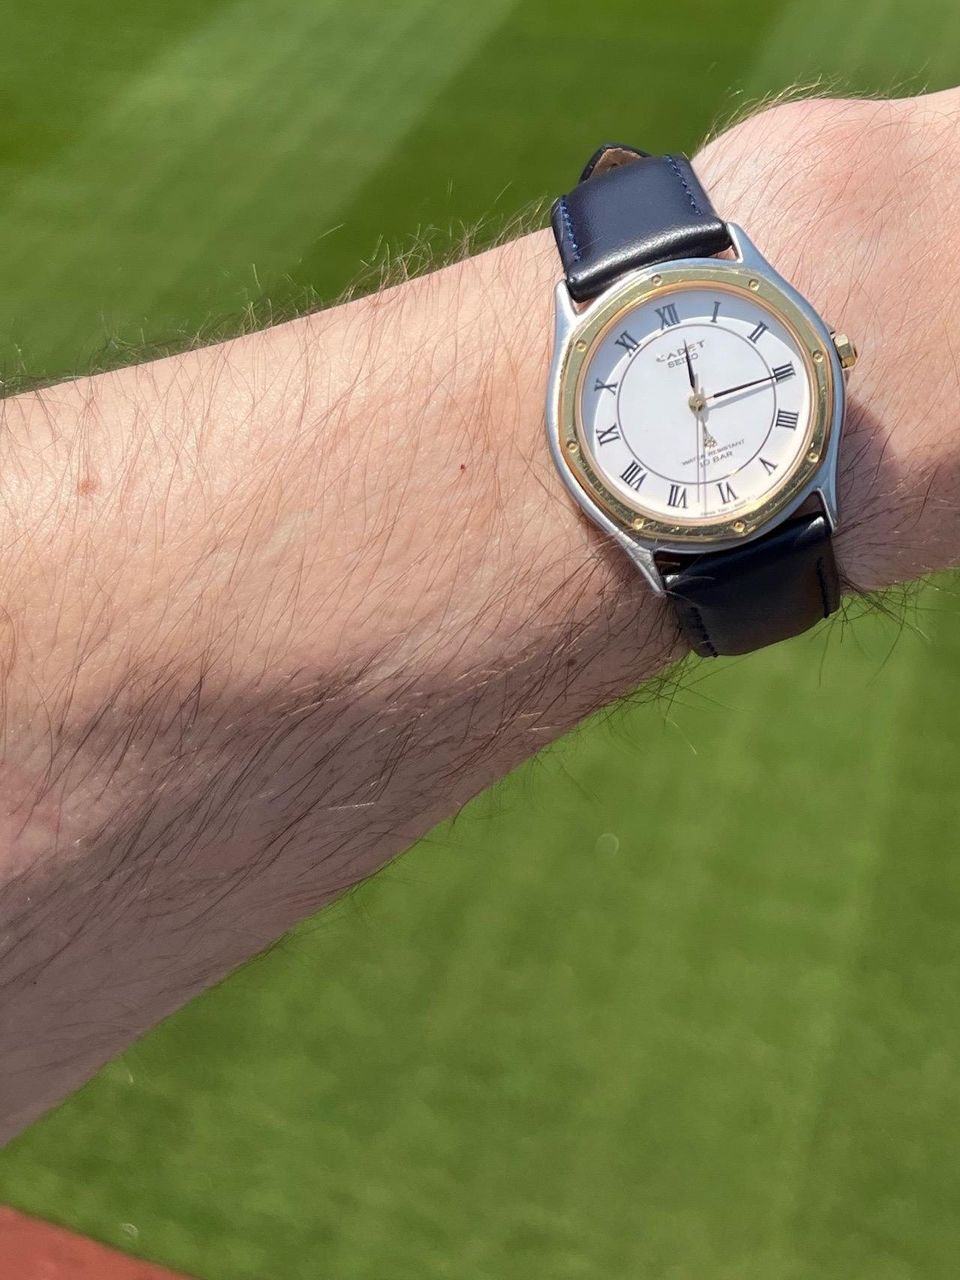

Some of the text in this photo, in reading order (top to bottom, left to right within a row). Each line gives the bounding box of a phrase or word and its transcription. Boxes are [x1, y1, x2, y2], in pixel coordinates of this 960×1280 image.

[654, 303, 680, 330] XII
[711, 301, 722, 322] I
[748, 321, 769, 343] II
[615, 331, 641, 357] XI
[668, 353, 699, 368] SEIO
[594, 378, 618, 395] X
[776, 409, 799, 430] IIII
[596, 424, 622, 446] IX
[682, 439, 745, 466] WATR RESISTANT
[713, 451, 733, 464] BAR
[620, 460, 648, 490] VIII
[759, 458, 777, 476] V
[668, 485, 689, 509] VII
[717, 482, 738, 504] VI
